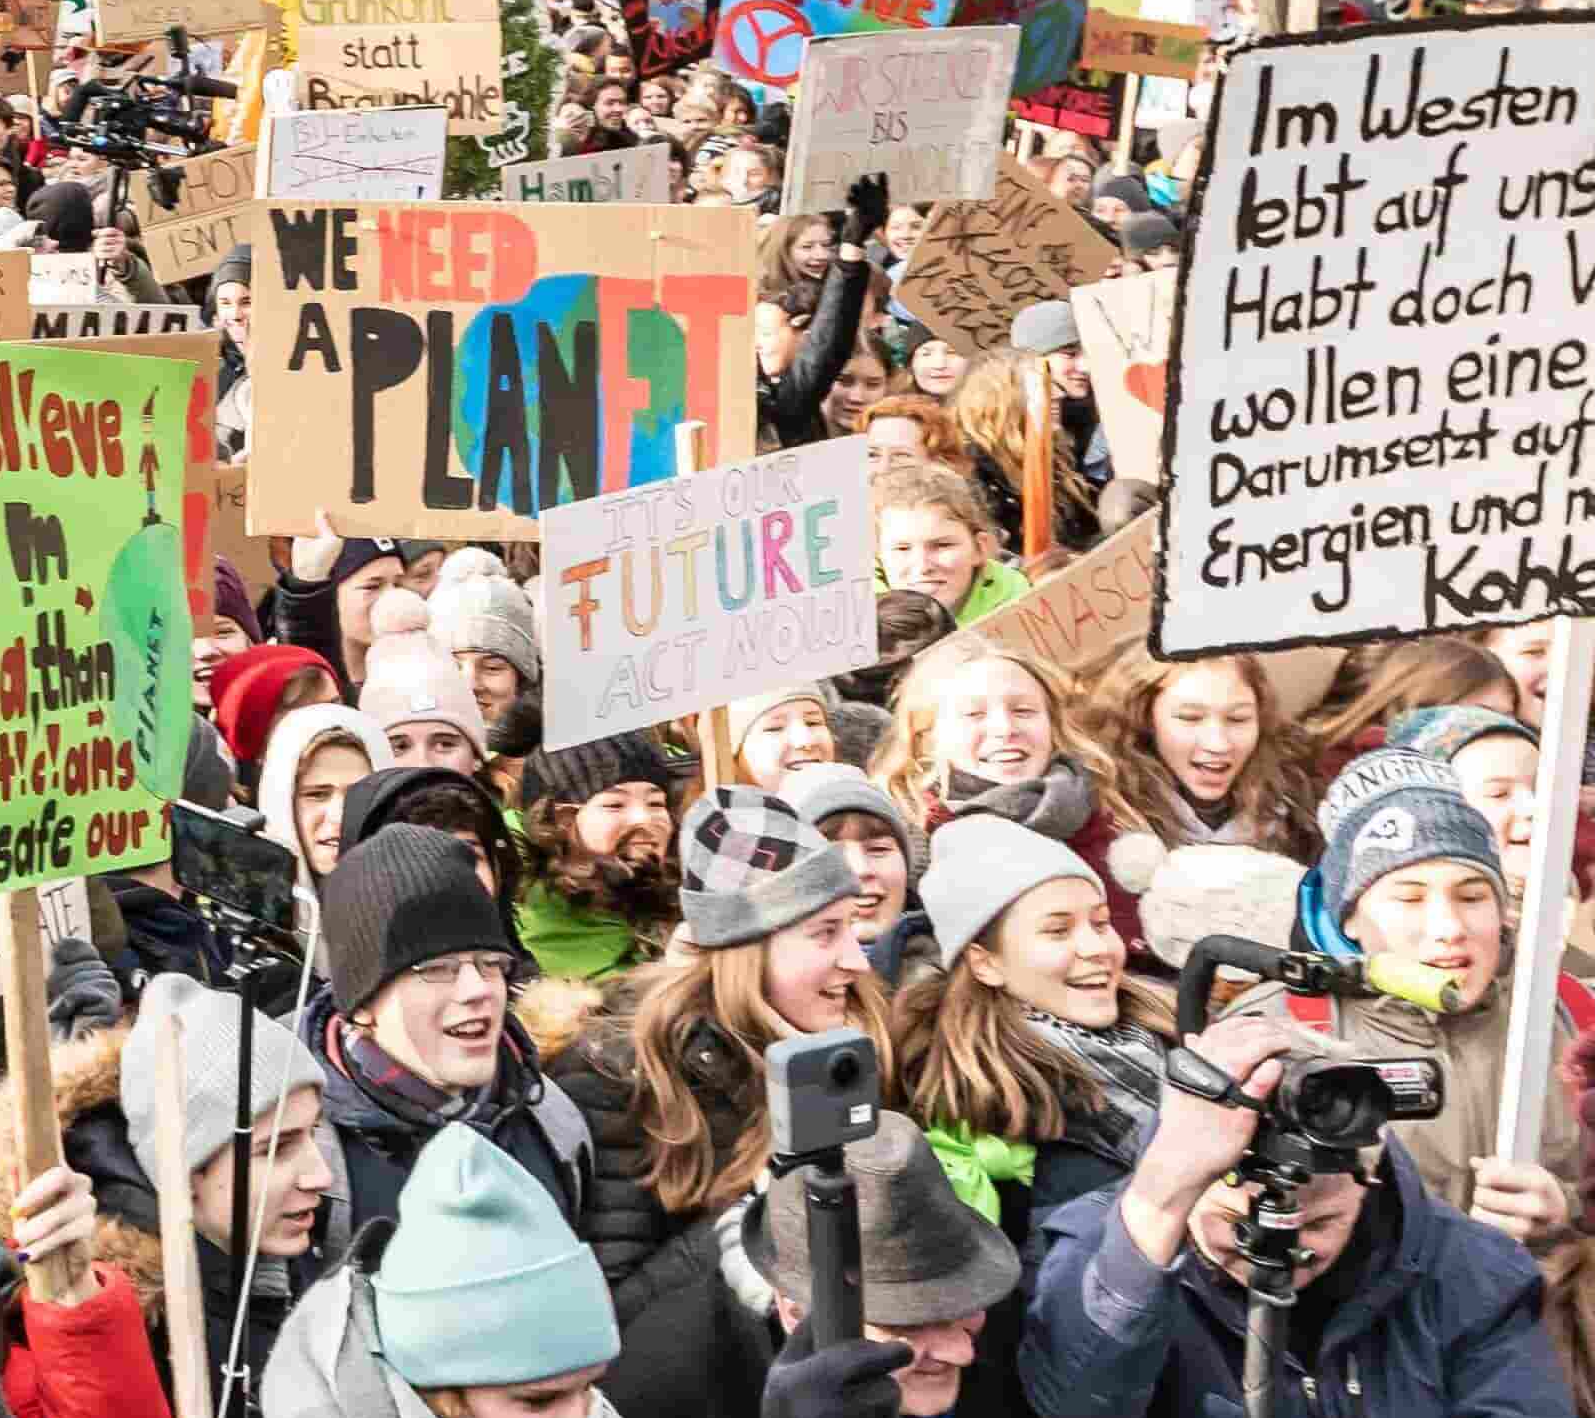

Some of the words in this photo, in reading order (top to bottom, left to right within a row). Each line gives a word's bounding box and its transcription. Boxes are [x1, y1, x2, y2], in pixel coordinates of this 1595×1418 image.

[342, 36, 424, 71] statt
[1251, 65, 1338, 156] Im
[1362, 46, 1577, 141] Westen
[269, 207, 358, 291] WE
[378, 208, 537, 303] NEED
[1237, 161, 1367, 253] lebt
[1374, 143, 1467, 256] auf
[1224, 269, 1376, 351] Habt
[1389, 239, 1534, 330] doch
[288, 302, 342, 373] A
[350, 273, 749, 515] PLANET
[1211, 347, 1422, 443] wollen
[1447, 329, 1590, 405] eine
[1511, 401, 1590, 480] auf
[601, 478, 692, 553] IT'S
[718, 449, 807, 521] OUR
[1201, 505, 1431, 613] Energien
[1447, 471, 1543, 543] und
[560, 498, 840, 653] FUTURE
[31, 609, 117, 711] than
[597, 635, 708, 720] ACT
[718, 584, 871, 681] NOW!
[86, 808, 150, 860] our
